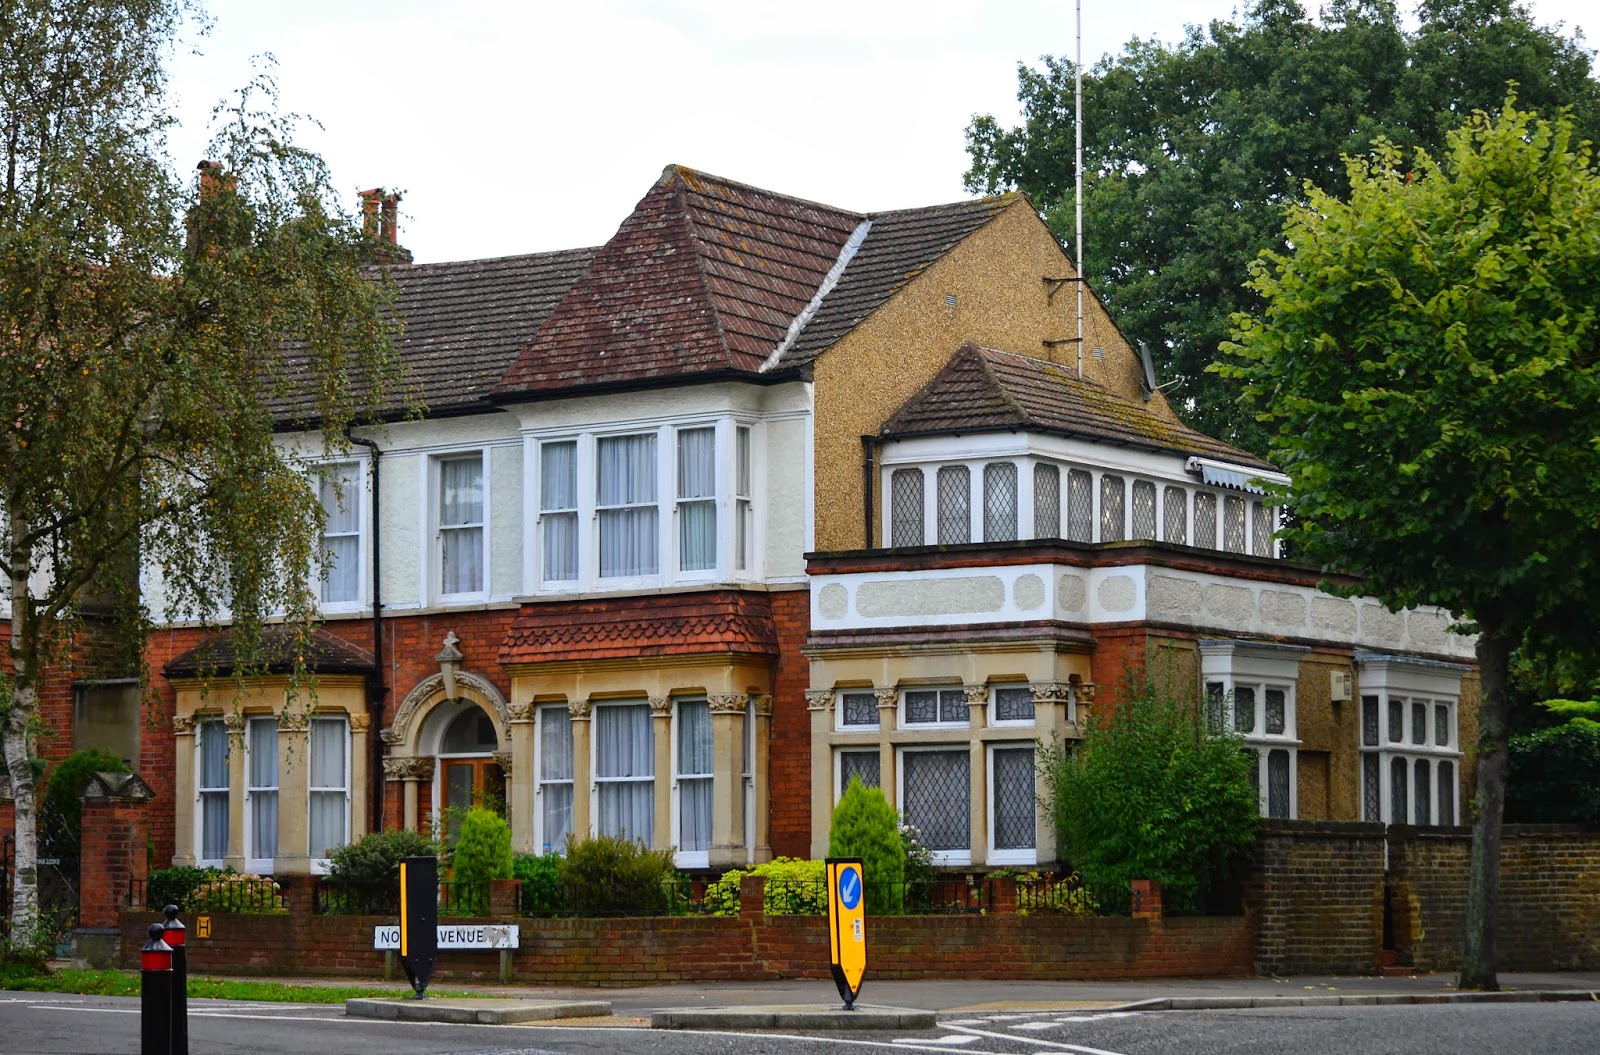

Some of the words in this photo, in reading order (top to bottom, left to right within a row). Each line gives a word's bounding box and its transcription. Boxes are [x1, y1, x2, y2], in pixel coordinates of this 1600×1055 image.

[198, 919, 209, 936] H
[381, 931, 400, 943] NO
[437, 930, 484, 943] VENUE
